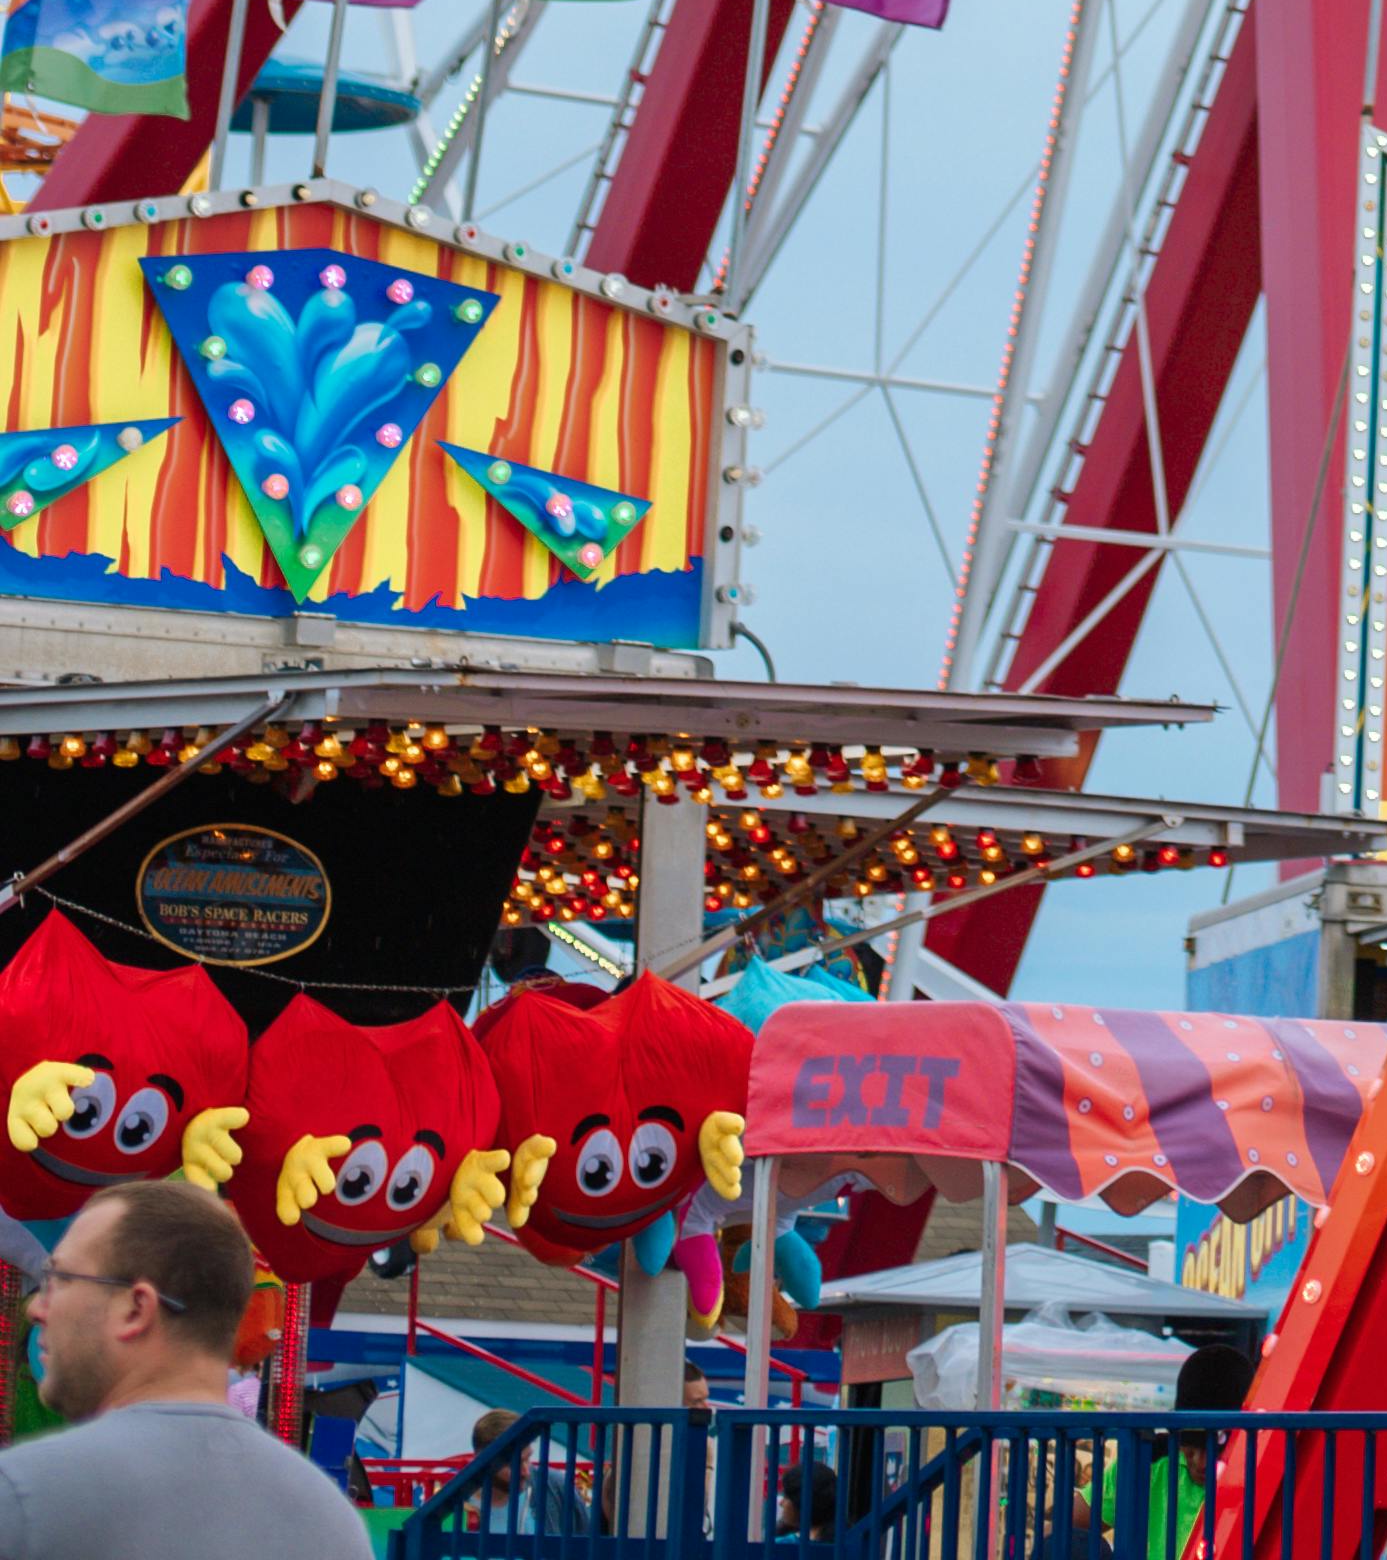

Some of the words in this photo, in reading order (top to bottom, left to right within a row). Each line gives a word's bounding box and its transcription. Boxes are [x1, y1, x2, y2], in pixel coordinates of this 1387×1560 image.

[207, 871, 321, 900] AMUSEMENTS
[159, 903, 200, 917] BOB'S
[204, 906, 249, 922] SPACE
[253, 910, 308, 925] RACERS
[791, 1053, 962, 1129] EXIT
